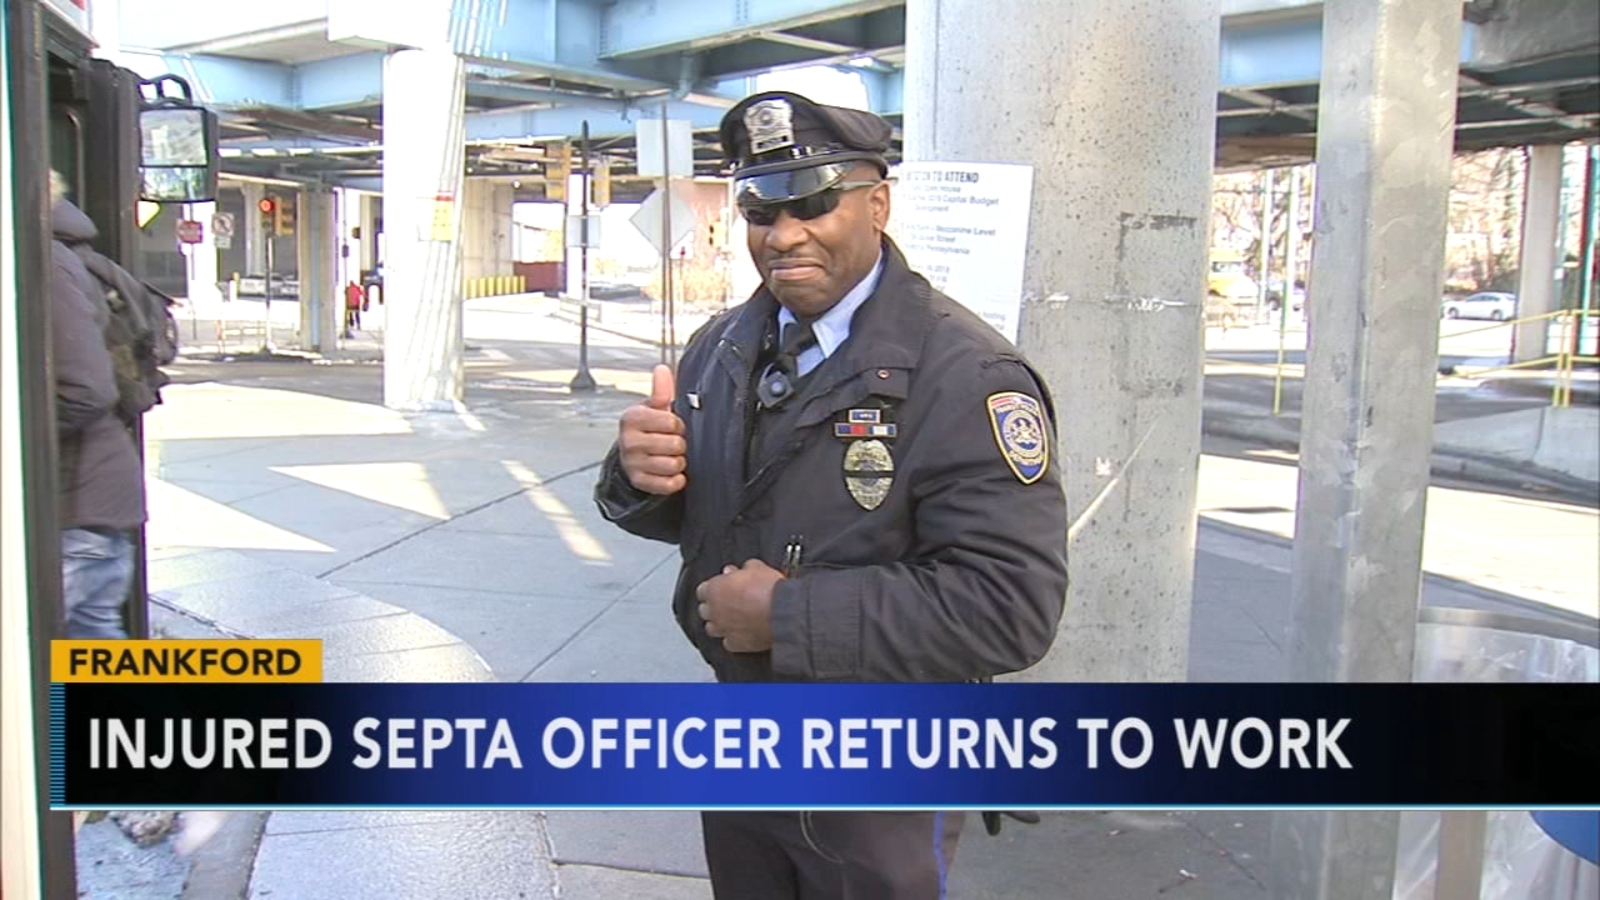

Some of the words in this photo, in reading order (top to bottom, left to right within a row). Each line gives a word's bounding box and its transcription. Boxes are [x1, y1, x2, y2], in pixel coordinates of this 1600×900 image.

[944, 171, 980, 184] ATTEND
[942, 194, 968, 204] Capital
[969, 195, 1000, 207] Budget
[973, 226, 997, 237] Level
